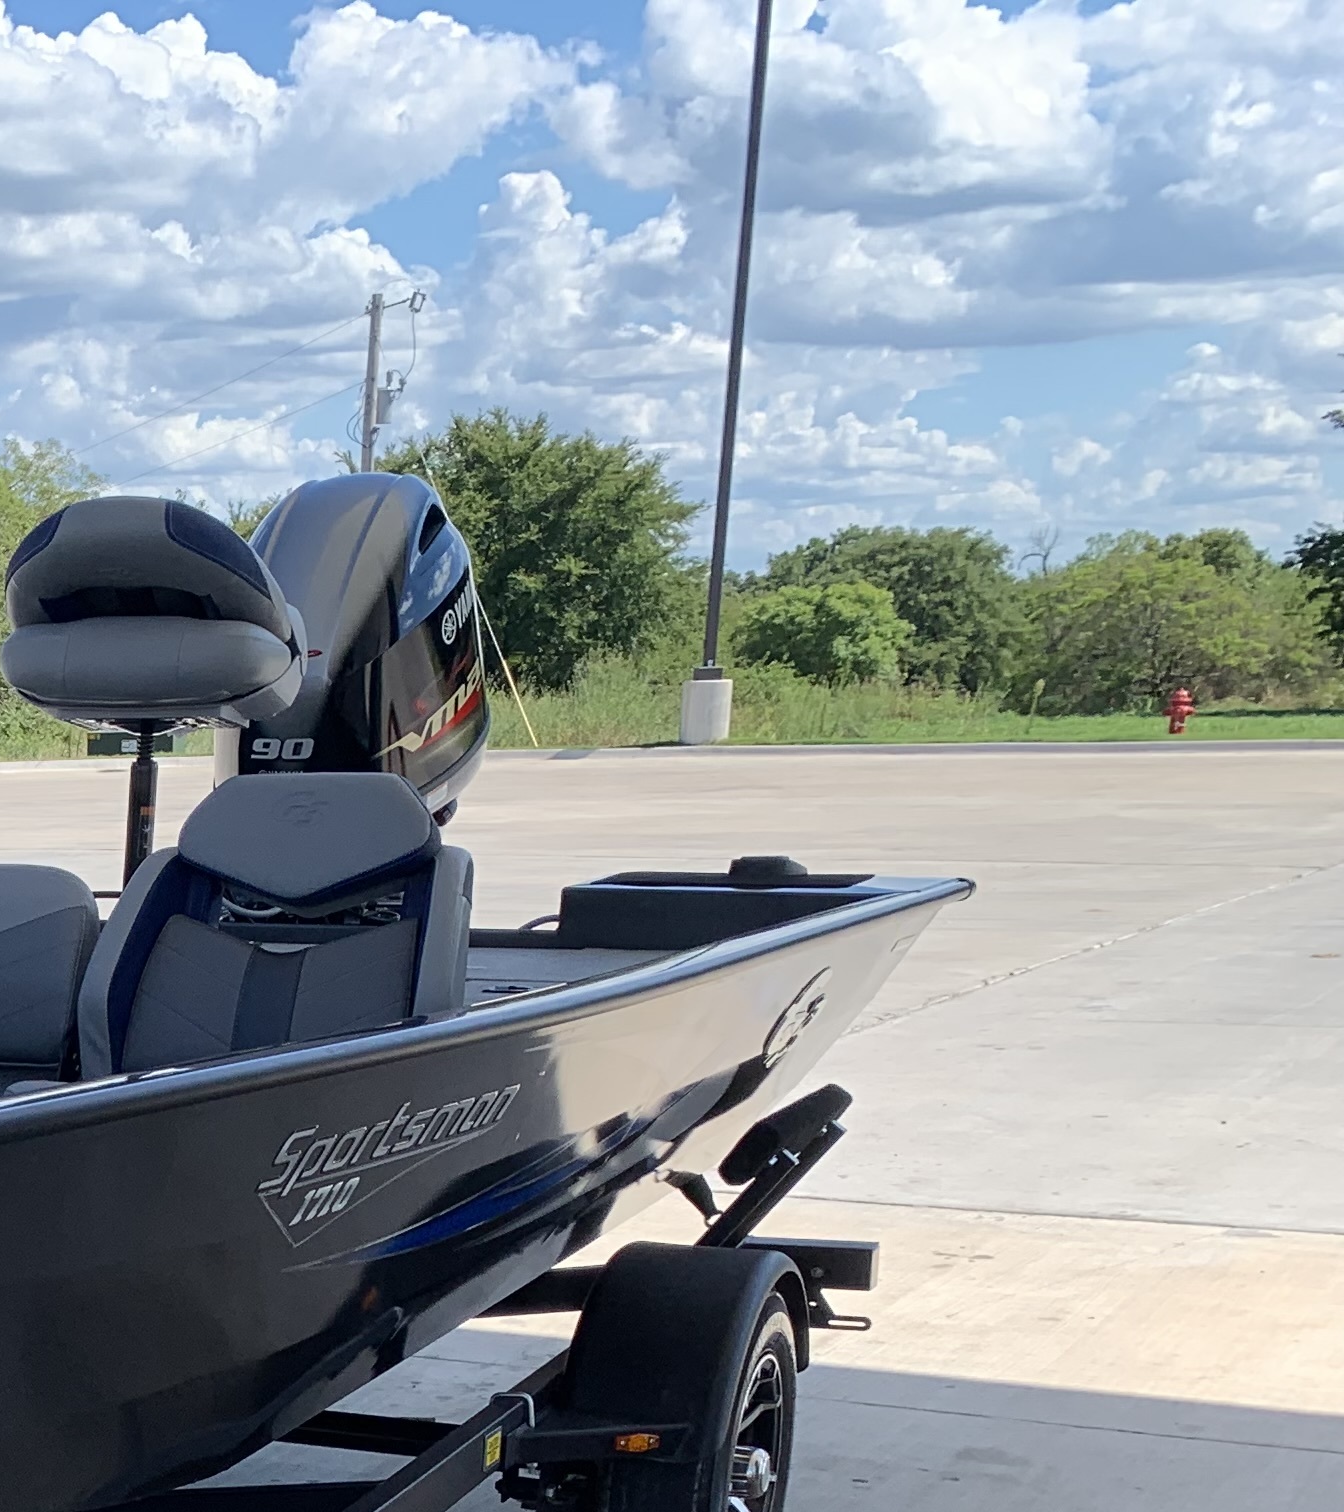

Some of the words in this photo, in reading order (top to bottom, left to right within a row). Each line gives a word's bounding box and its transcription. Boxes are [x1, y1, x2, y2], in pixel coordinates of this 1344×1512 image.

[250, 737, 315, 760] 90
[256, 1083, 521, 1198] Sportsman
[288, 1176, 361, 1227] 1710
